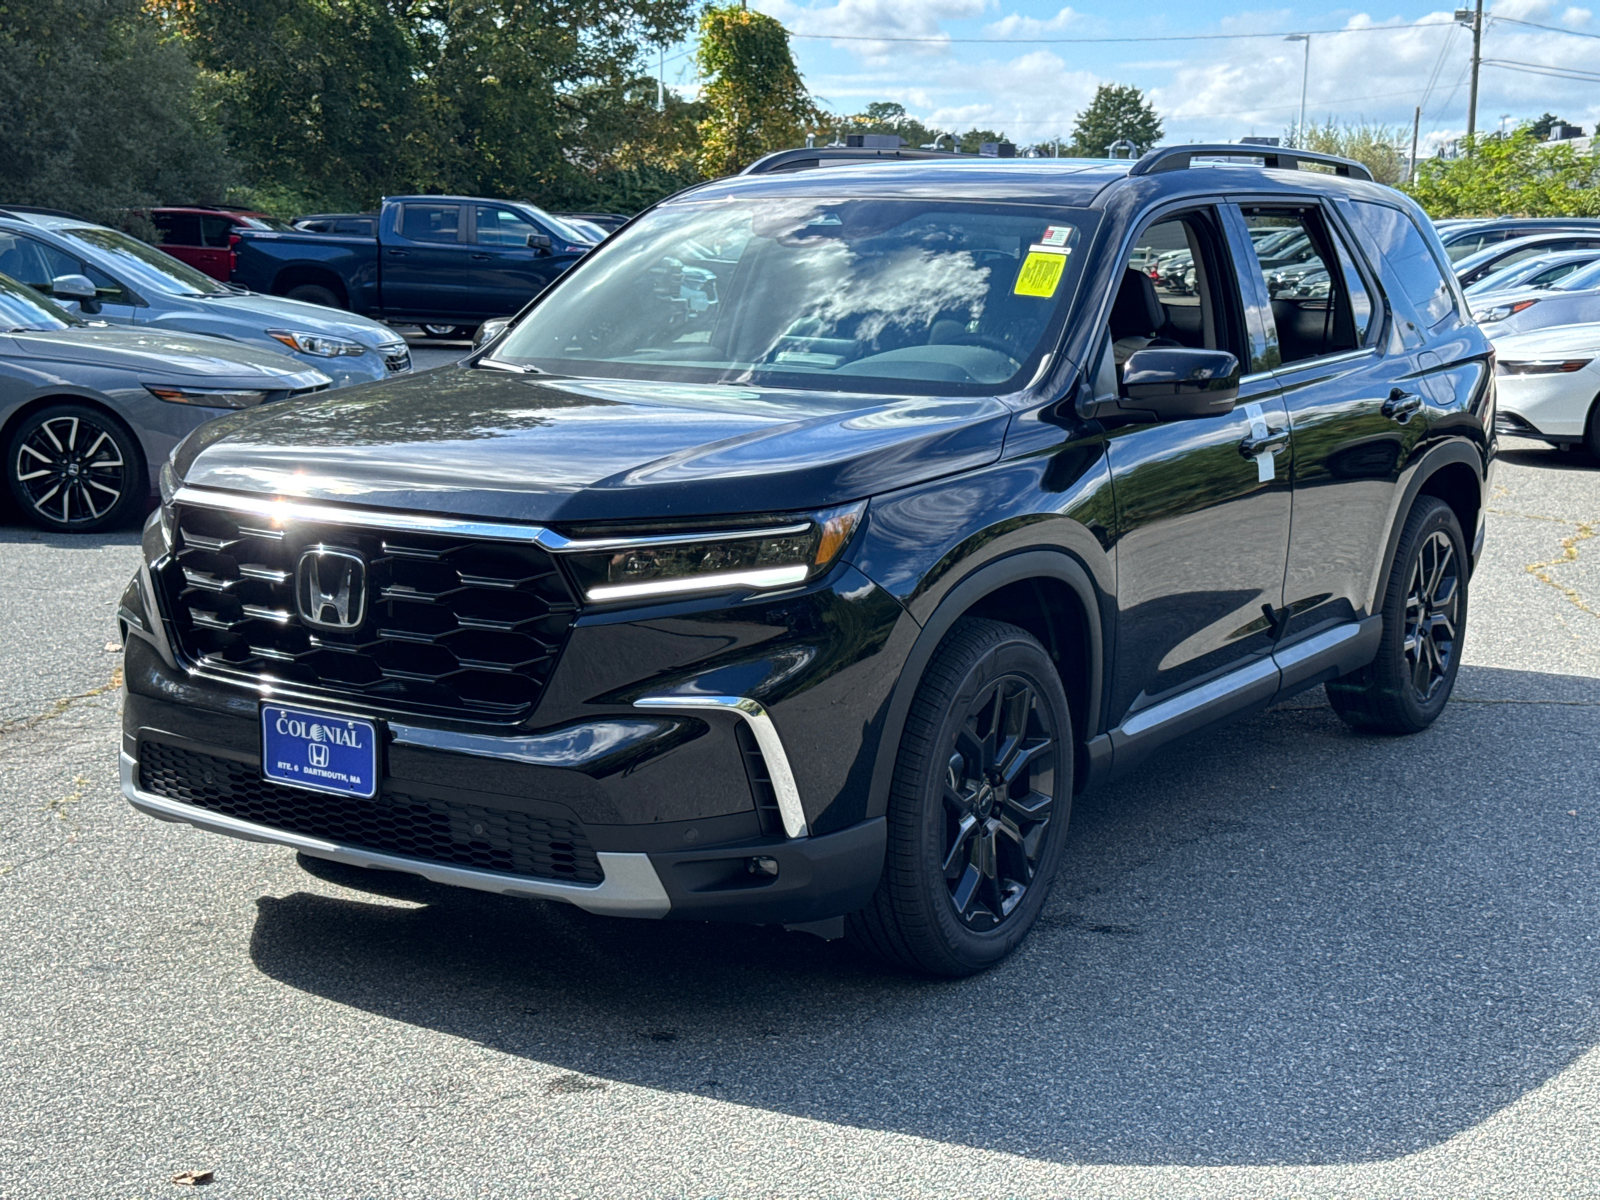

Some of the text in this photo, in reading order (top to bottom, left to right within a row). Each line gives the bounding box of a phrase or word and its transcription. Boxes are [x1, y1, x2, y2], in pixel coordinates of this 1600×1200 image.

[276, 717, 362, 749] COLONIAL
[277, 761, 293, 771] RTE.
[303, 766, 349, 783] DARTMOUTH,
[350, 775, 361, 784] MA
